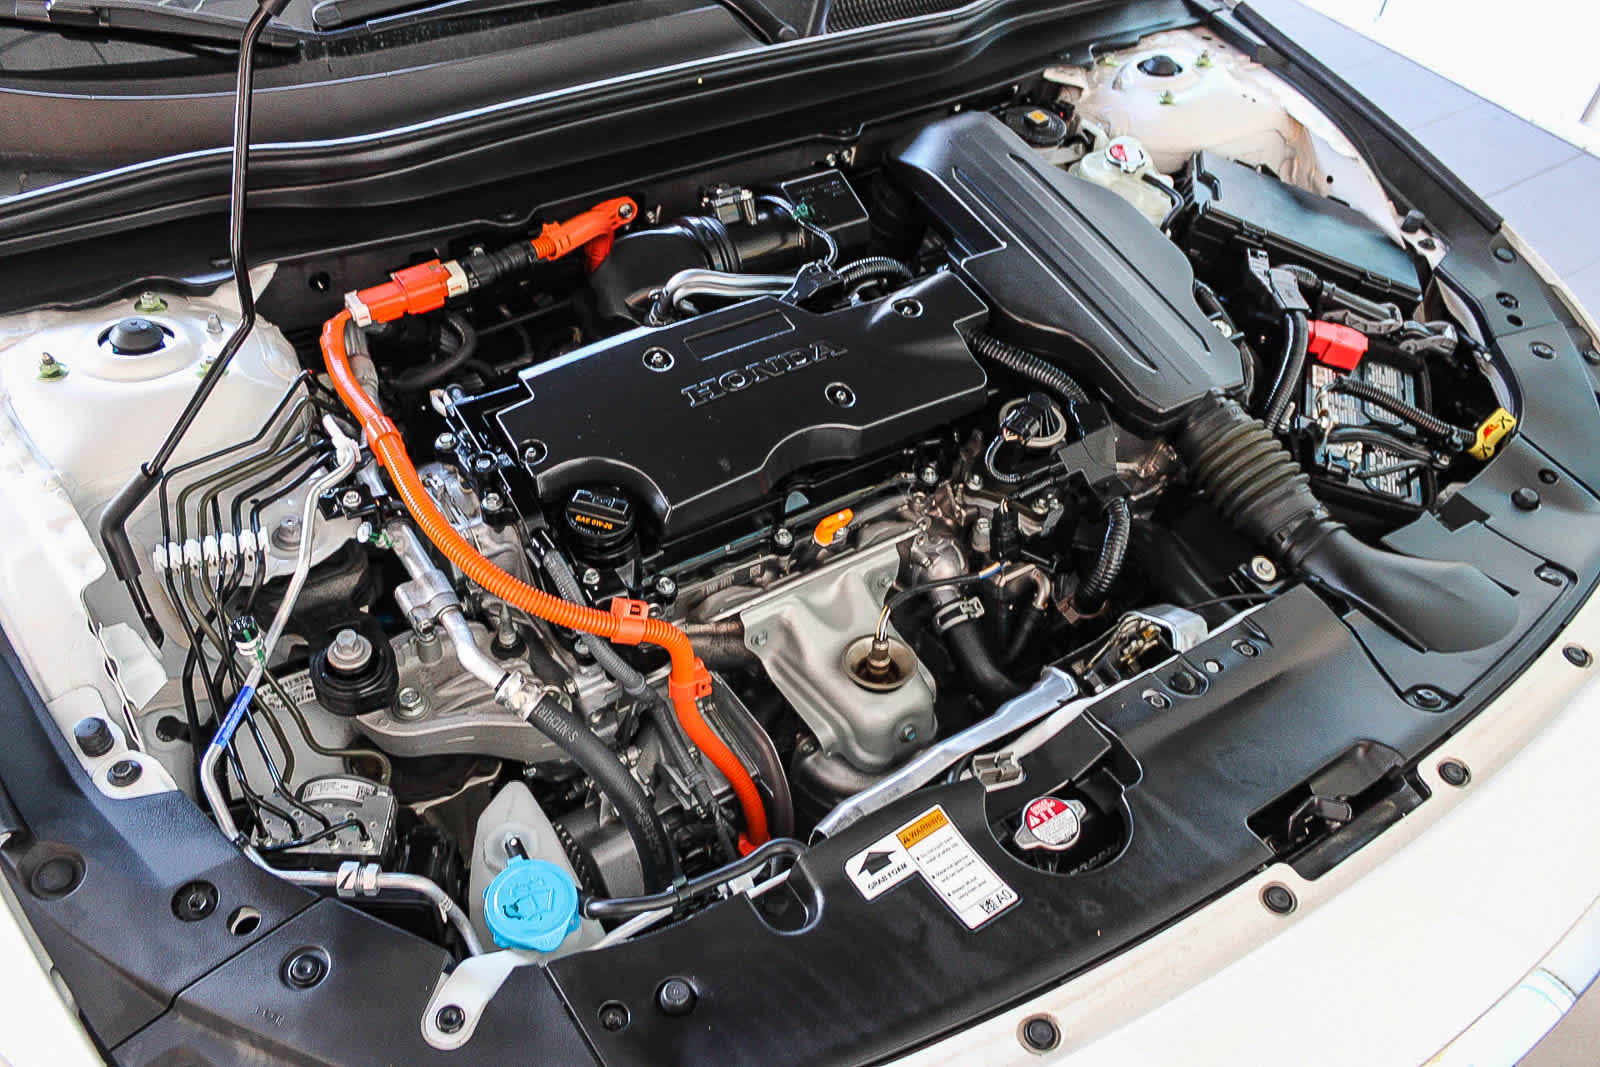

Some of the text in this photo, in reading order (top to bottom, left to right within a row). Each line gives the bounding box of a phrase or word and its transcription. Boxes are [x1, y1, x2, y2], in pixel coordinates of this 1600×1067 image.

[681, 340, 849, 407] HONDA
[575, 514, 591, 525] SAE
[910, 814, 944, 840] WARNING
[867, 862, 907, 889] GRAB FOAM
